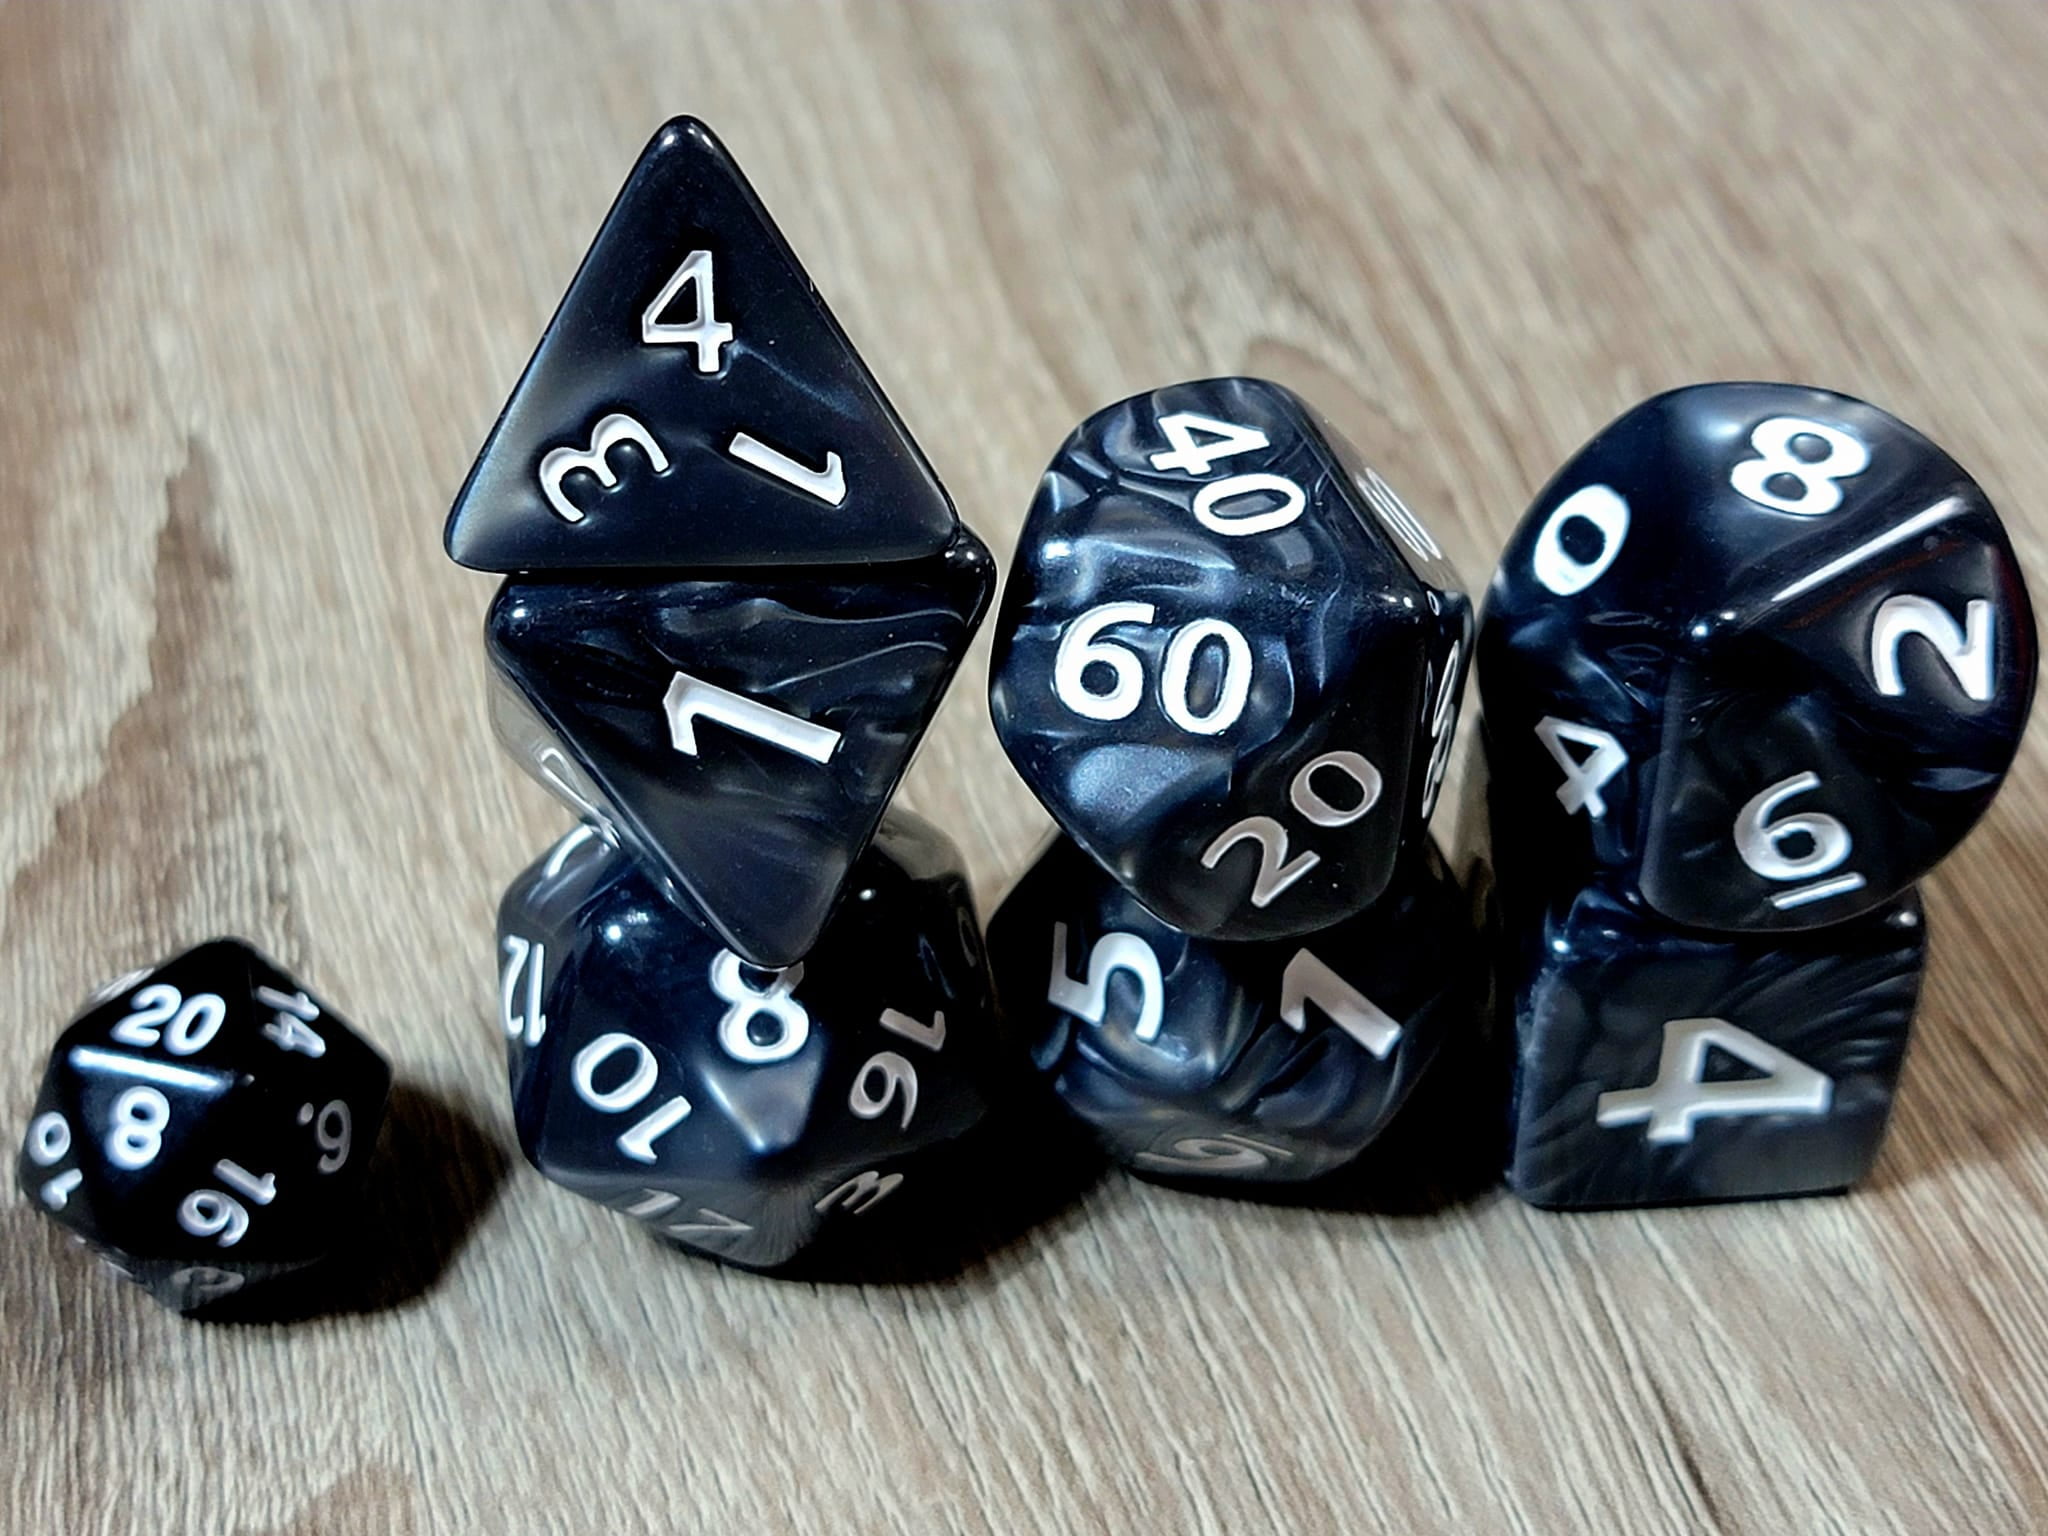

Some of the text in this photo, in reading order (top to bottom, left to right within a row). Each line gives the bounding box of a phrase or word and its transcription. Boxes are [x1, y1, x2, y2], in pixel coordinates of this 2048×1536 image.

[642, 250, 734, 372] 4
[539, 413, 670, 523] 3
[728, 431, 848, 507] 1
[1150, 412, 1307, 536] 40
[1730, 416, 1871, 517] 8
[1534, 484, 1631, 596] 0
[1054, 601, 1253, 735] 60
[1872, 594, 1997, 701] 2
[663, 671, 841, 764] 1
[1534, 716, 1629, 818] 4
[1201, 751, 1383, 907] 20
[110, 984, 226, 1056] 20
[258, 985, 326, 1058] 14
[709, 948, 809, 1063] 8
[1048, 921, 1164, 1042] 5
[1281, 948, 1402, 1061] 1
[572, 1032, 692, 1164] 10
[848, 1008, 947, 1131] 16
[1597, 1017, 1833, 1146] 4
[29, 1112, 83, 1210] 10
[109, 1086, 170, 1170] 8
[178, 1158, 277, 1248] 16
